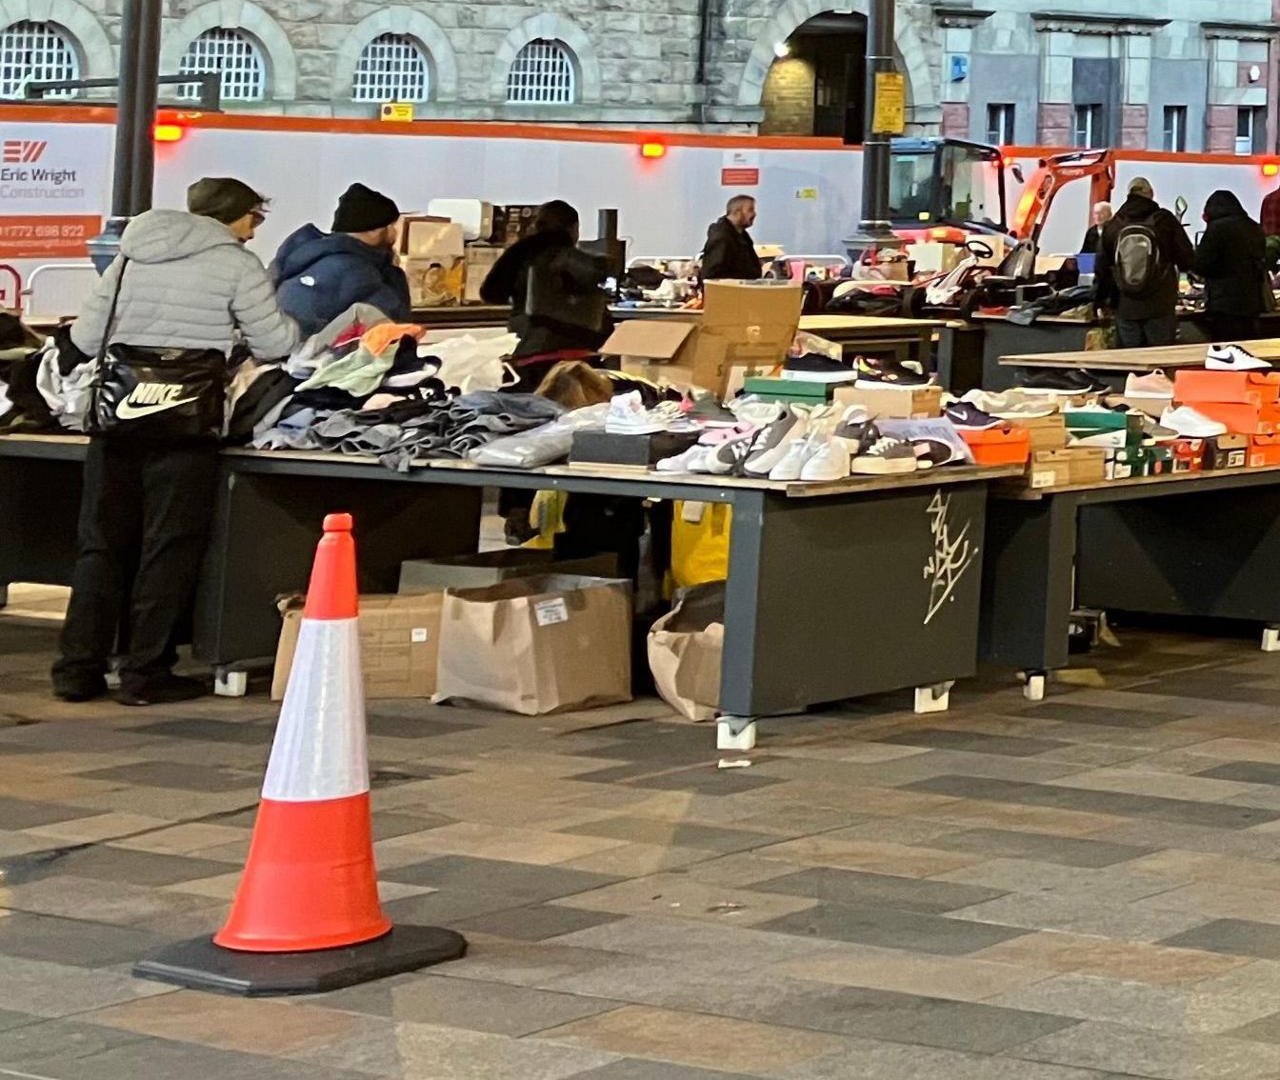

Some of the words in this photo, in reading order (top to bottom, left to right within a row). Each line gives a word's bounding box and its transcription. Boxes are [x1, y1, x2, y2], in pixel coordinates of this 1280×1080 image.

[0, 168, 29, 181] Eric
[32, 168, 77, 185] Wright
[0, 185, 85, 199] Construction
[0, 225, 33, 237] 1772
[128, 382, 184, 405] NIKE
